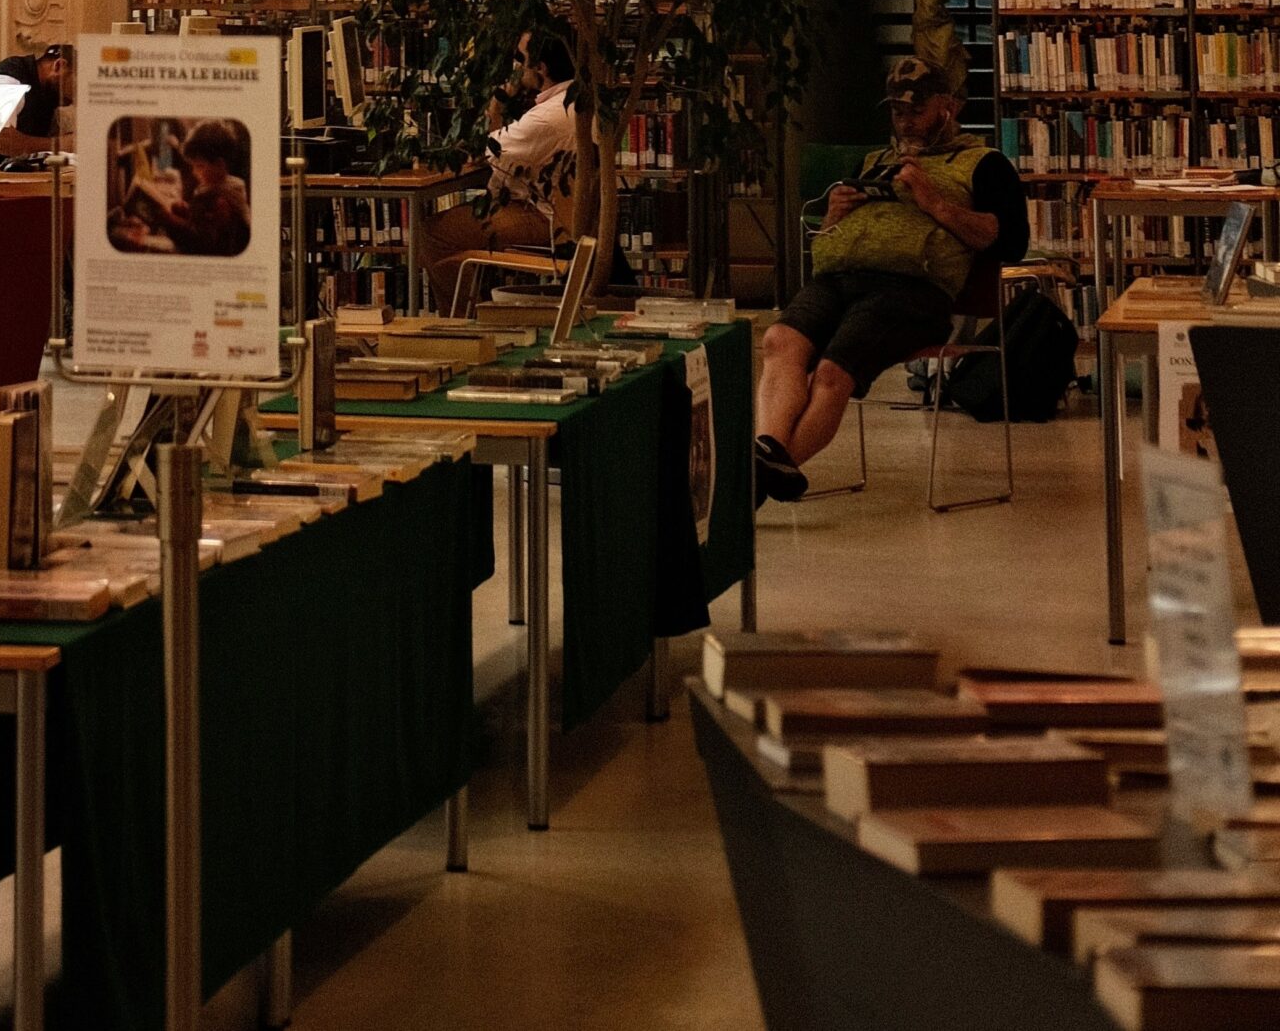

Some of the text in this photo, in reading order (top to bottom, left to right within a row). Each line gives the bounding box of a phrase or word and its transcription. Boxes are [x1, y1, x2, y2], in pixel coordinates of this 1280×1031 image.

[98, 66, 259, 81] MASCHI TRA LE RIGHE
